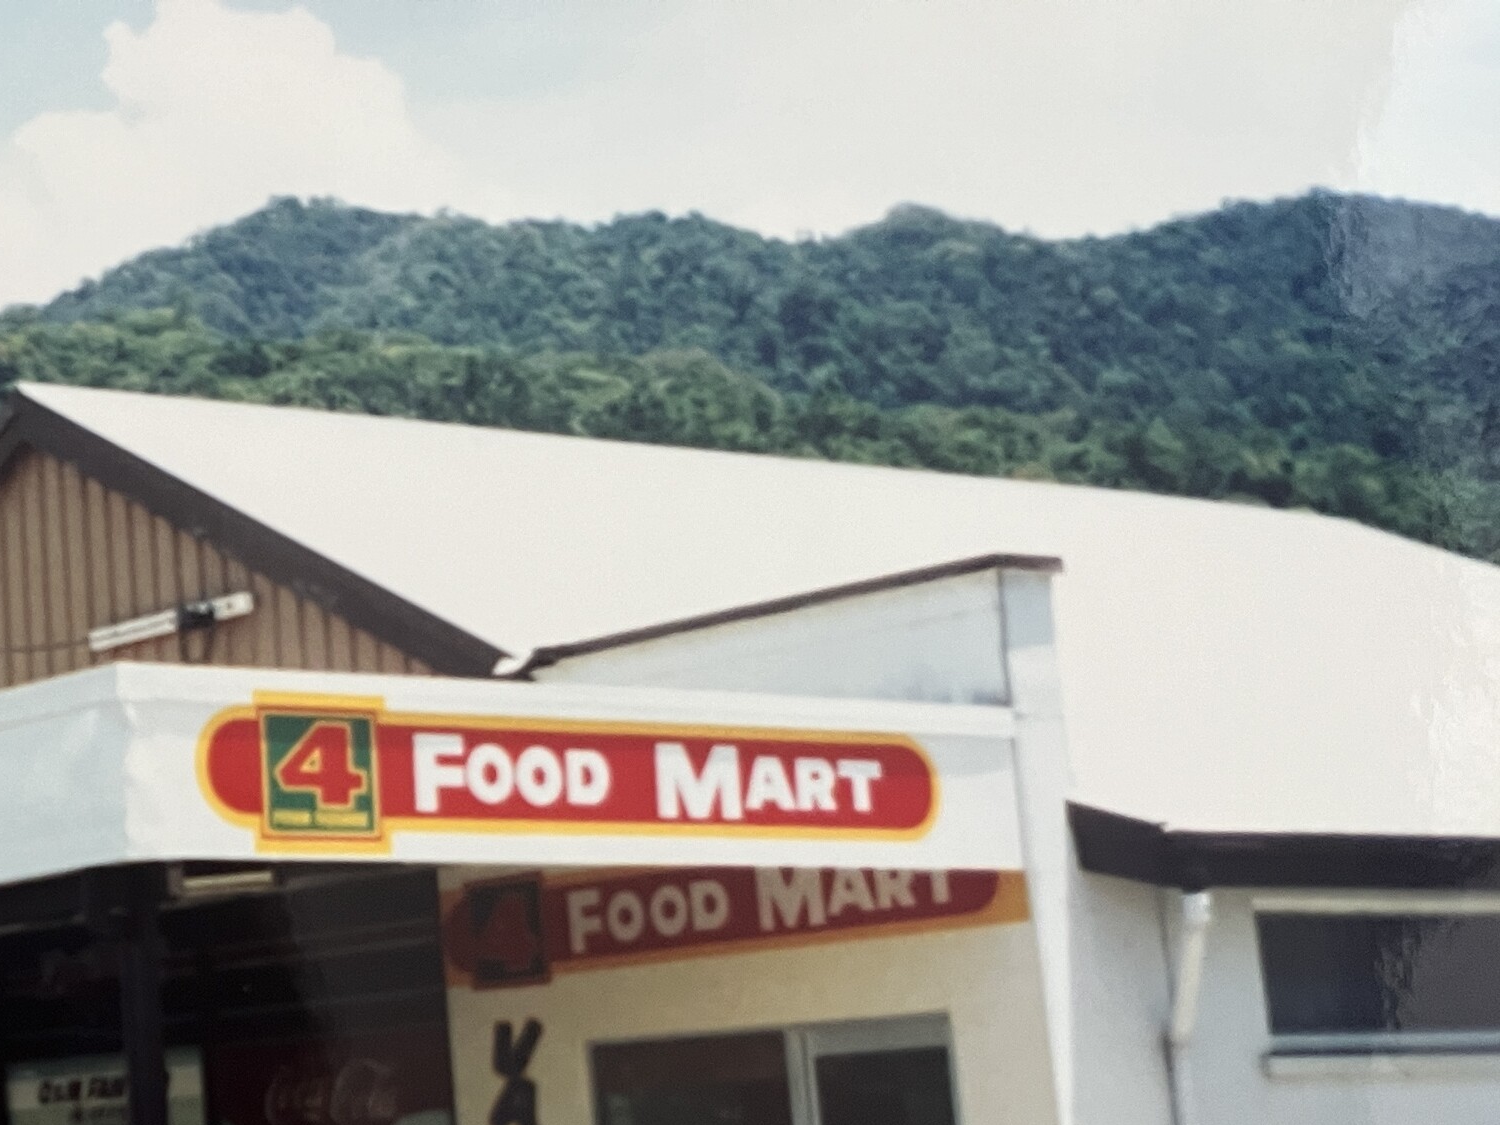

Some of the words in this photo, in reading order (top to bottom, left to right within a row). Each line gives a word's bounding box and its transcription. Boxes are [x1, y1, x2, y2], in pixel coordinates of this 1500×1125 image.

[274, 720, 368, 808] 4
[412, 731, 612, 812] FOOD
[654, 741, 883, 821] MART
[565, 879, 730, 955] FOOD
